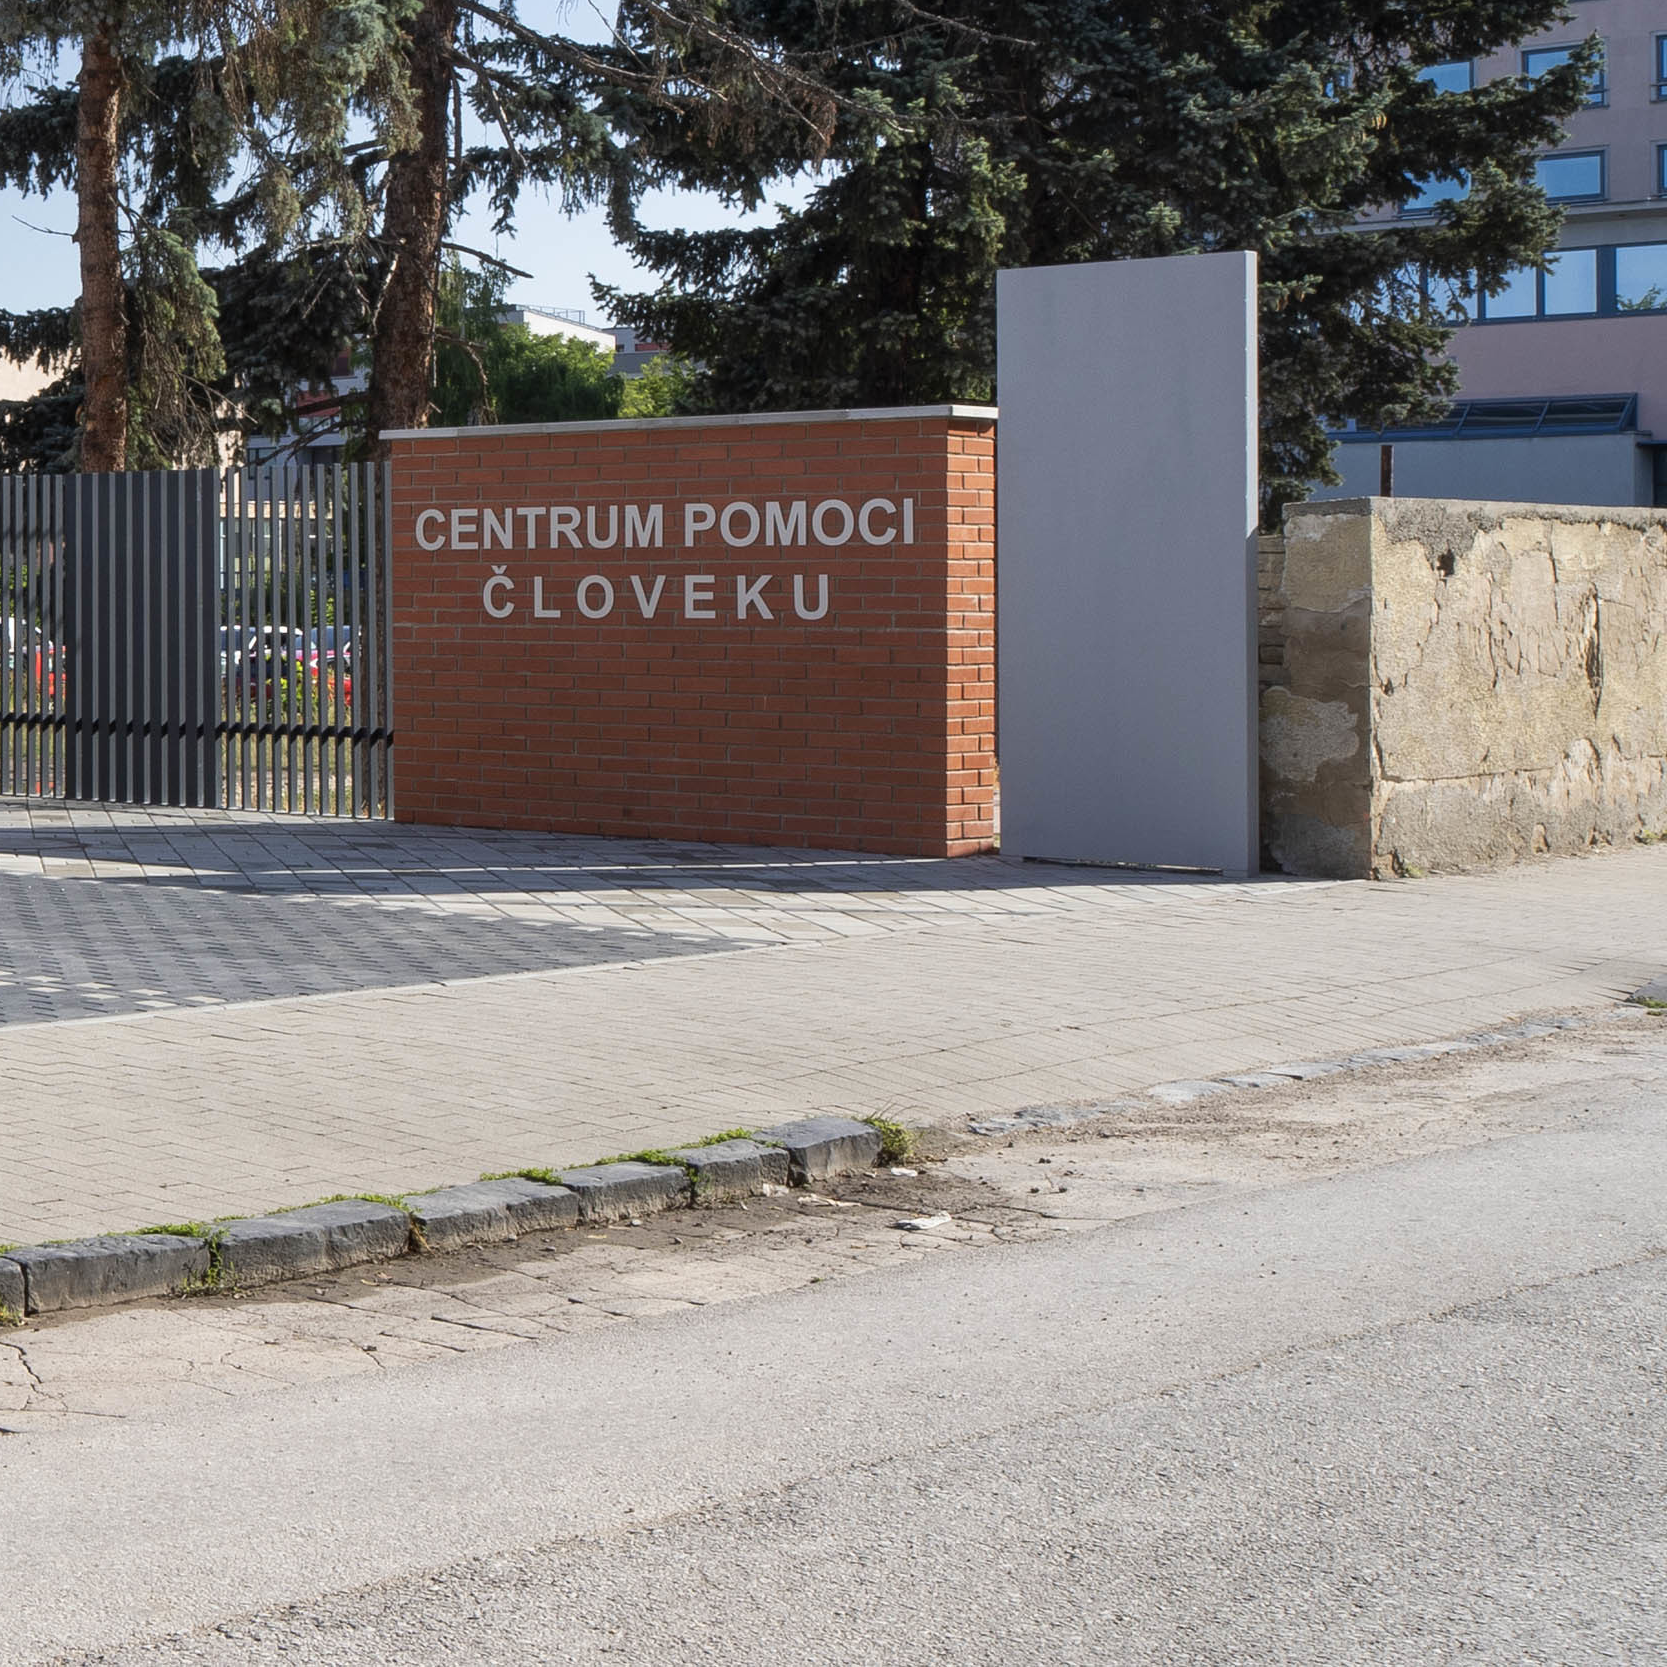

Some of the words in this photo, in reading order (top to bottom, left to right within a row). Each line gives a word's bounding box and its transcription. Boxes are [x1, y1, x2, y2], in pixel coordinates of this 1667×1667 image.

[415, 504, 664, 551] CENTRUM
[684, 497, 915, 547] POMOCI
[482, 565, 830, 620] ČLOVEKU
